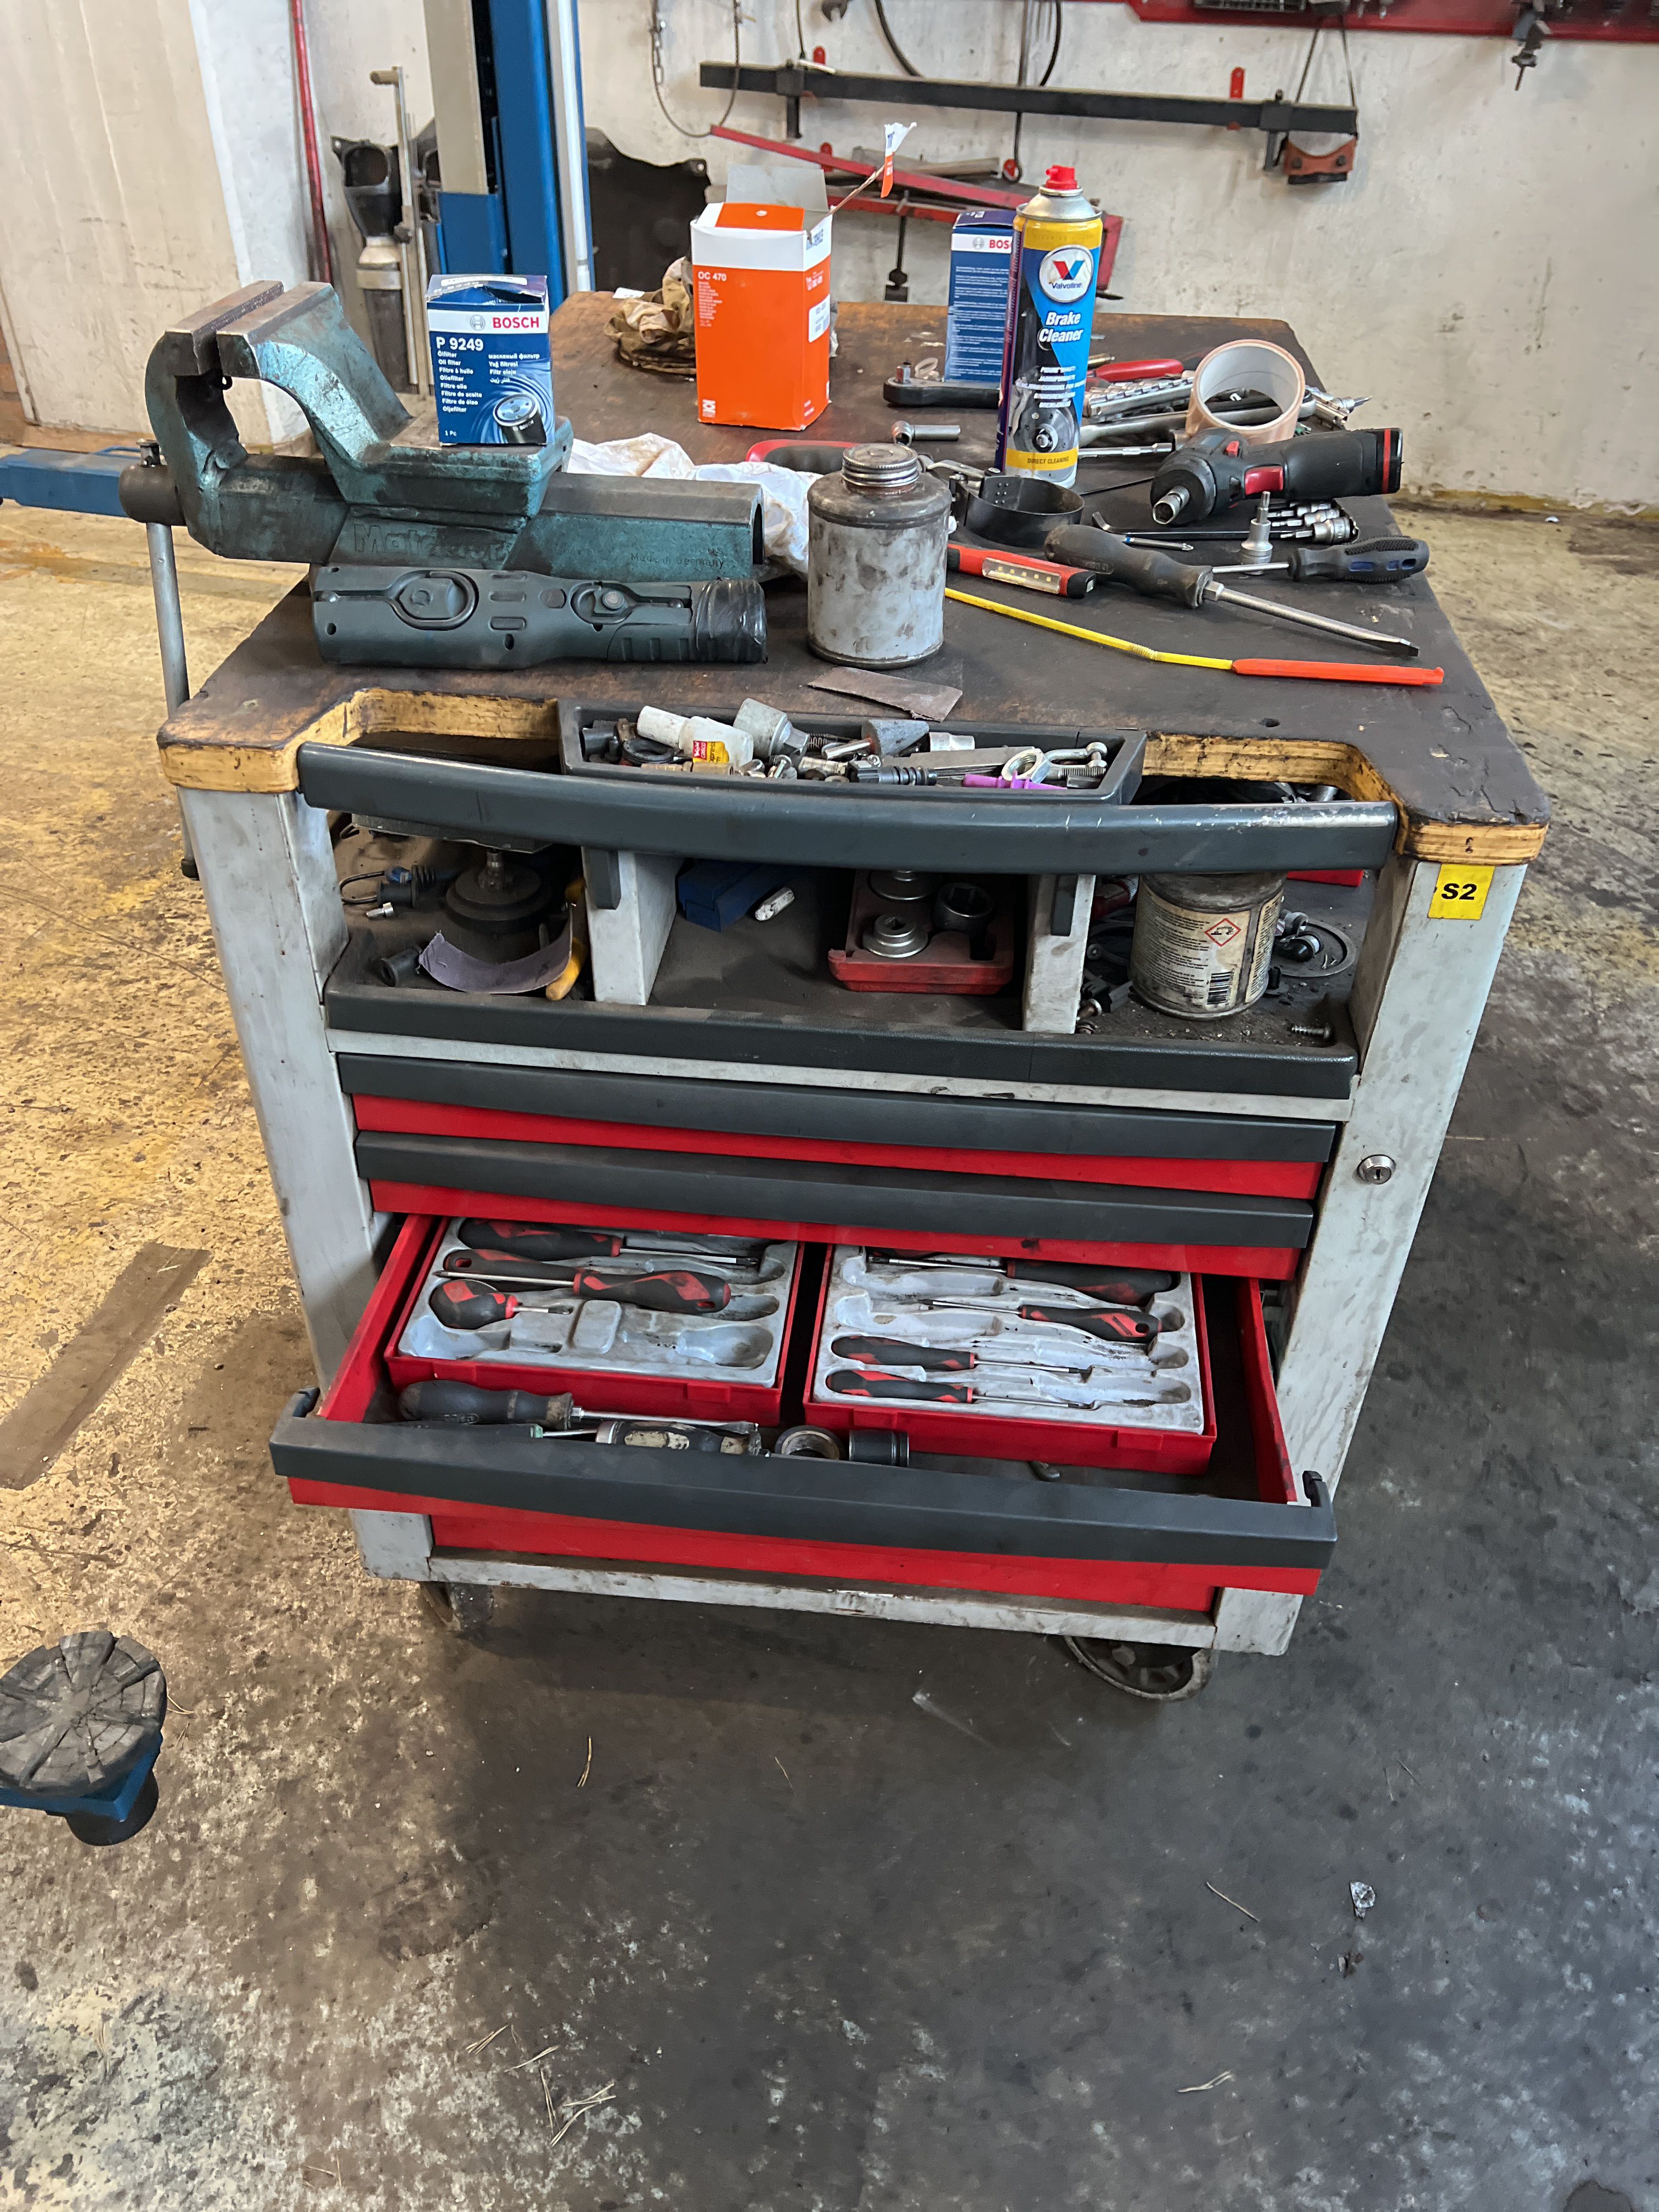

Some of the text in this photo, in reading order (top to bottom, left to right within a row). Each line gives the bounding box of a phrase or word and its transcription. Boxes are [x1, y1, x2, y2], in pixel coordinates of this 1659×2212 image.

[989, 239, 1012, 249] BOS
[698, 271, 726, 281] OC 470
[492, 317, 539, 329] BOSCH
[1045, 311, 1081, 326] Brake
[1039, 328, 1084, 342] Cleaner
[436, 336, 484, 351] P 9249
[631, 552, 724, 569] Made in Germany
[1441, 883, 1477, 900] S2
